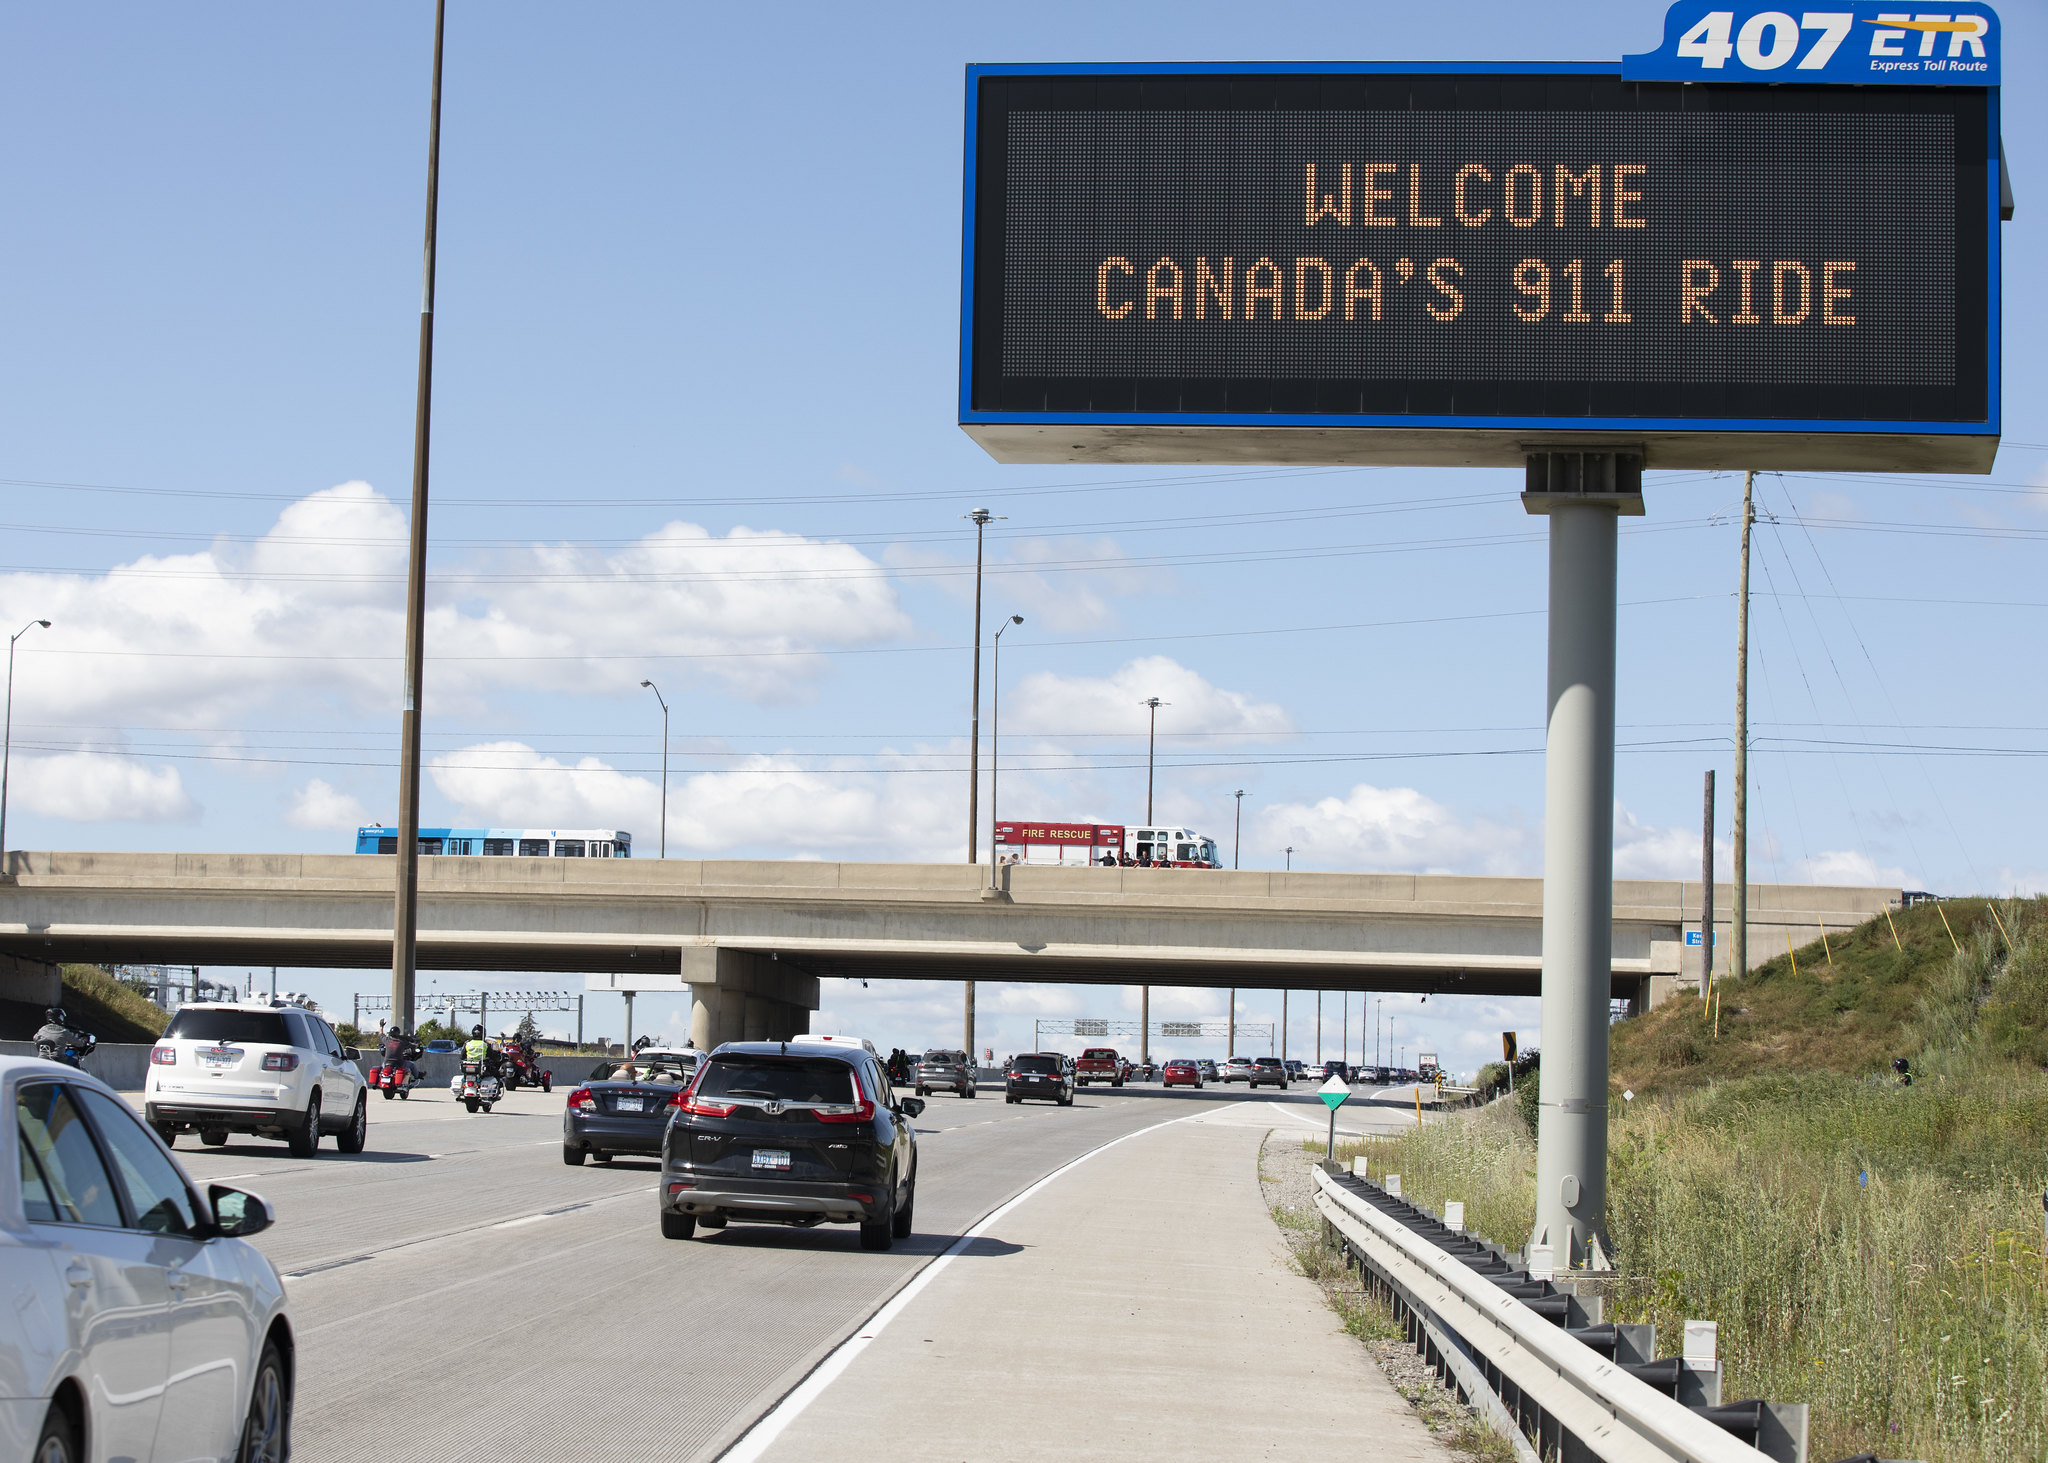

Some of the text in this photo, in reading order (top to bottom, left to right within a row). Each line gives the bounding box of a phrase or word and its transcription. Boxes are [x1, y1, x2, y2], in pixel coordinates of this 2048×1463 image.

[1676, 11, 1989, 71] 407 ETR
[1870, 60, 1988, 73] Express Toll Route
[1305, 163, 1646, 228] WELCOME
[1097, 256, 1856, 325] CANADA'S 911 RIDE
[1022, 829, 1091, 839] FIRE RESCUE
